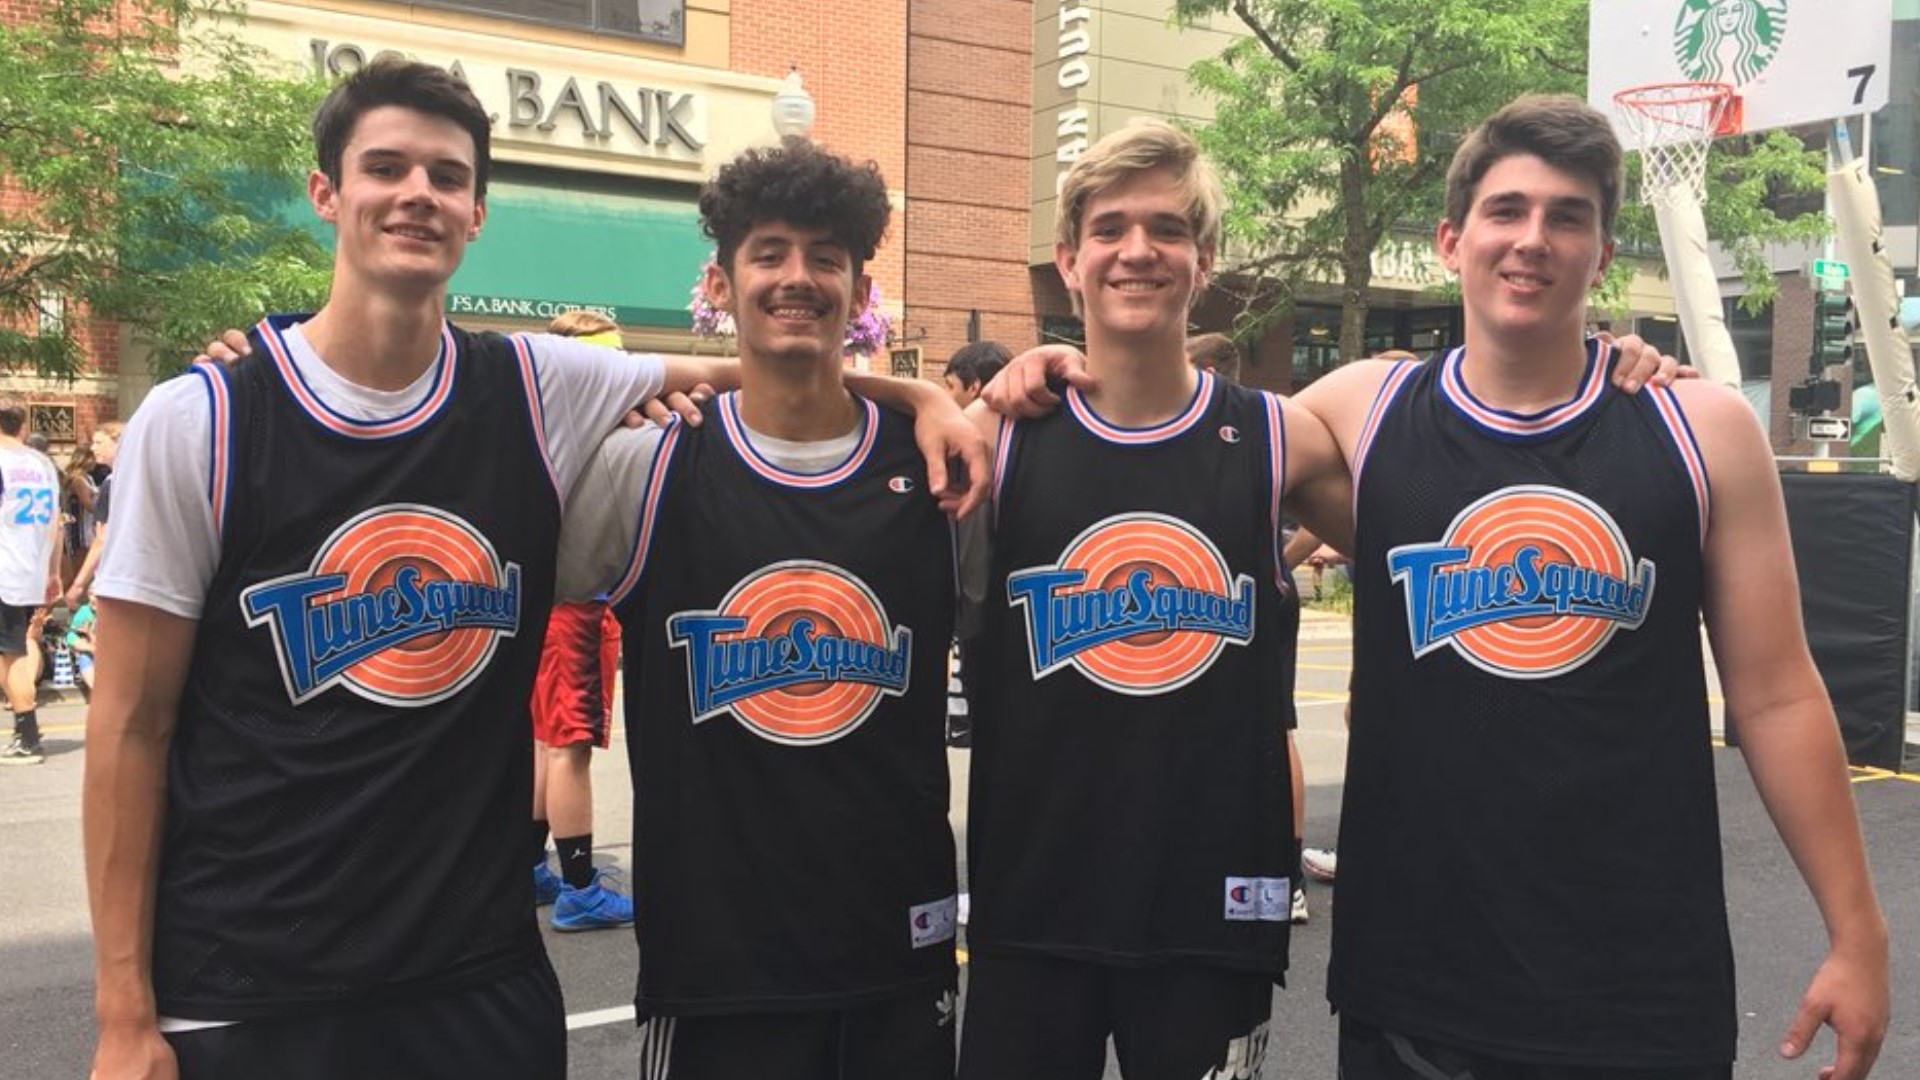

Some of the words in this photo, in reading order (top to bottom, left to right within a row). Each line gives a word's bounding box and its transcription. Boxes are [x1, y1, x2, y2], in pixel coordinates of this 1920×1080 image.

[1847, 64, 1876, 105] 7
[506, 67, 704, 151] BANK
[1056, 108, 1088, 203] AN
[491, 298, 535, 317] BANK
[14, 487, 53, 525] 23
